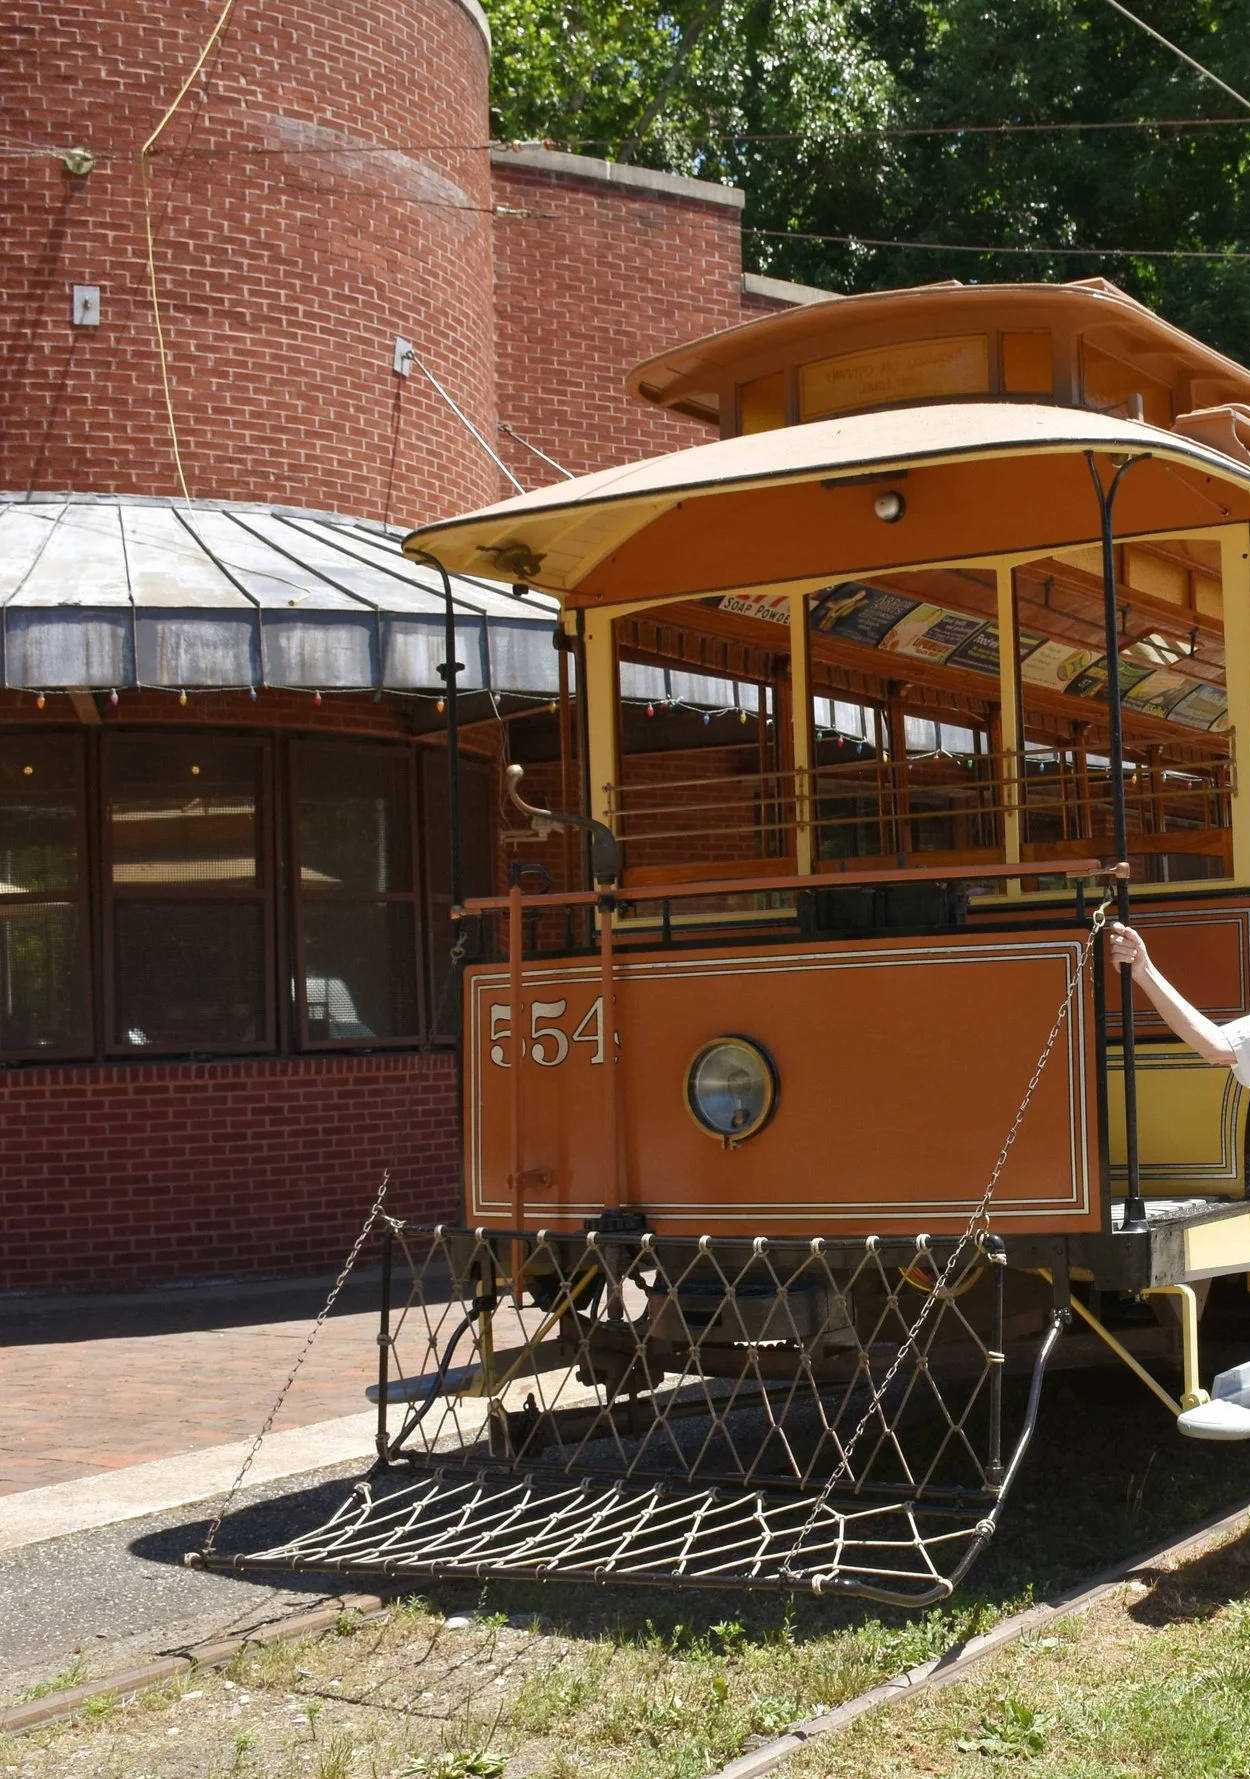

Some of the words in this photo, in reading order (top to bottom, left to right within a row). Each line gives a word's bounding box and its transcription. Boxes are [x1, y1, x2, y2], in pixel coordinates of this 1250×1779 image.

[723, 597, 752, 613] SOAP
[754, 605, 791, 625] POWDE
[489, 995, 622, 1069] 554
